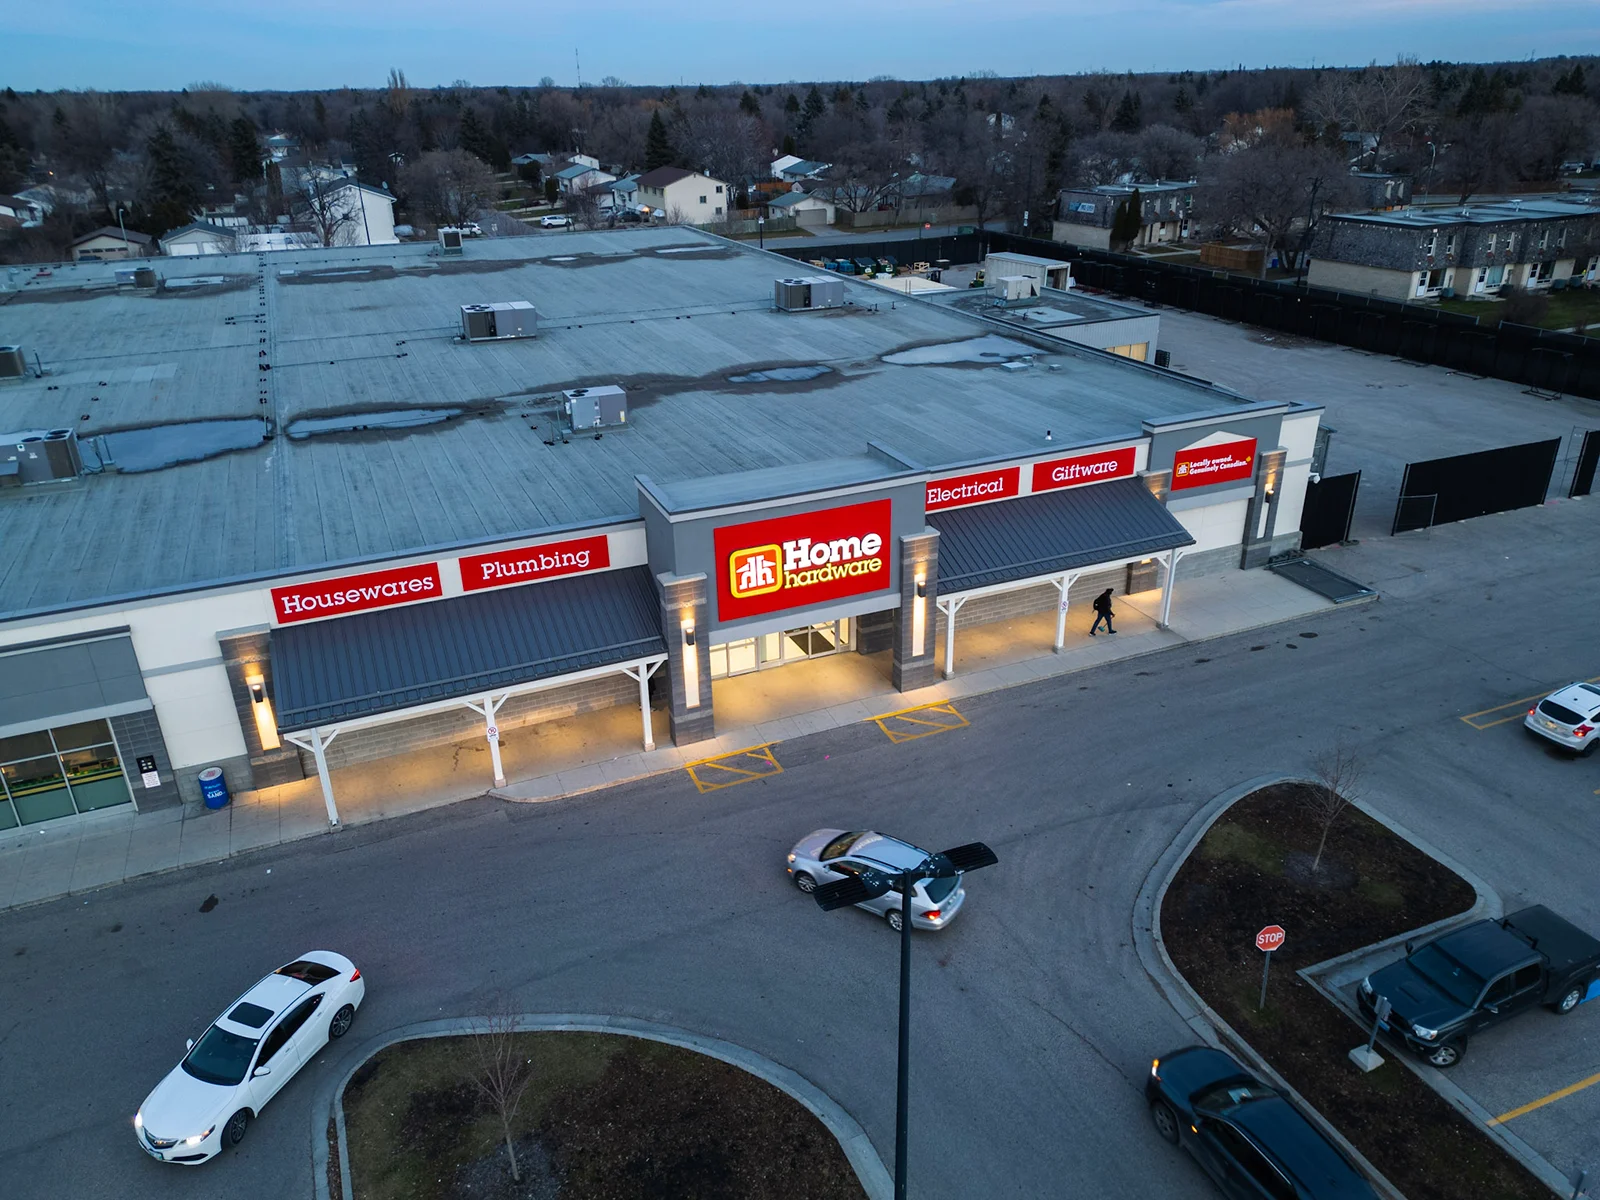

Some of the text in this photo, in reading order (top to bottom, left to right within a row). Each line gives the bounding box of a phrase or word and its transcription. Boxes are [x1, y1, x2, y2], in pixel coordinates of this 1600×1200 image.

[1051, 460, 1118, 482] Giftware
[1190, 454, 1232, 468] Locally owned.
[1190, 464, 1218, 474] Genuinely
[926, 477, 1004, 504] Electrical
[480, 549, 590, 580] Plumbing
[782, 532, 882, 570] Home
[784, 558, 882, 588] hardware
[281, 575, 434, 614] Housewares
[1258, 932, 1283, 945] STOP
